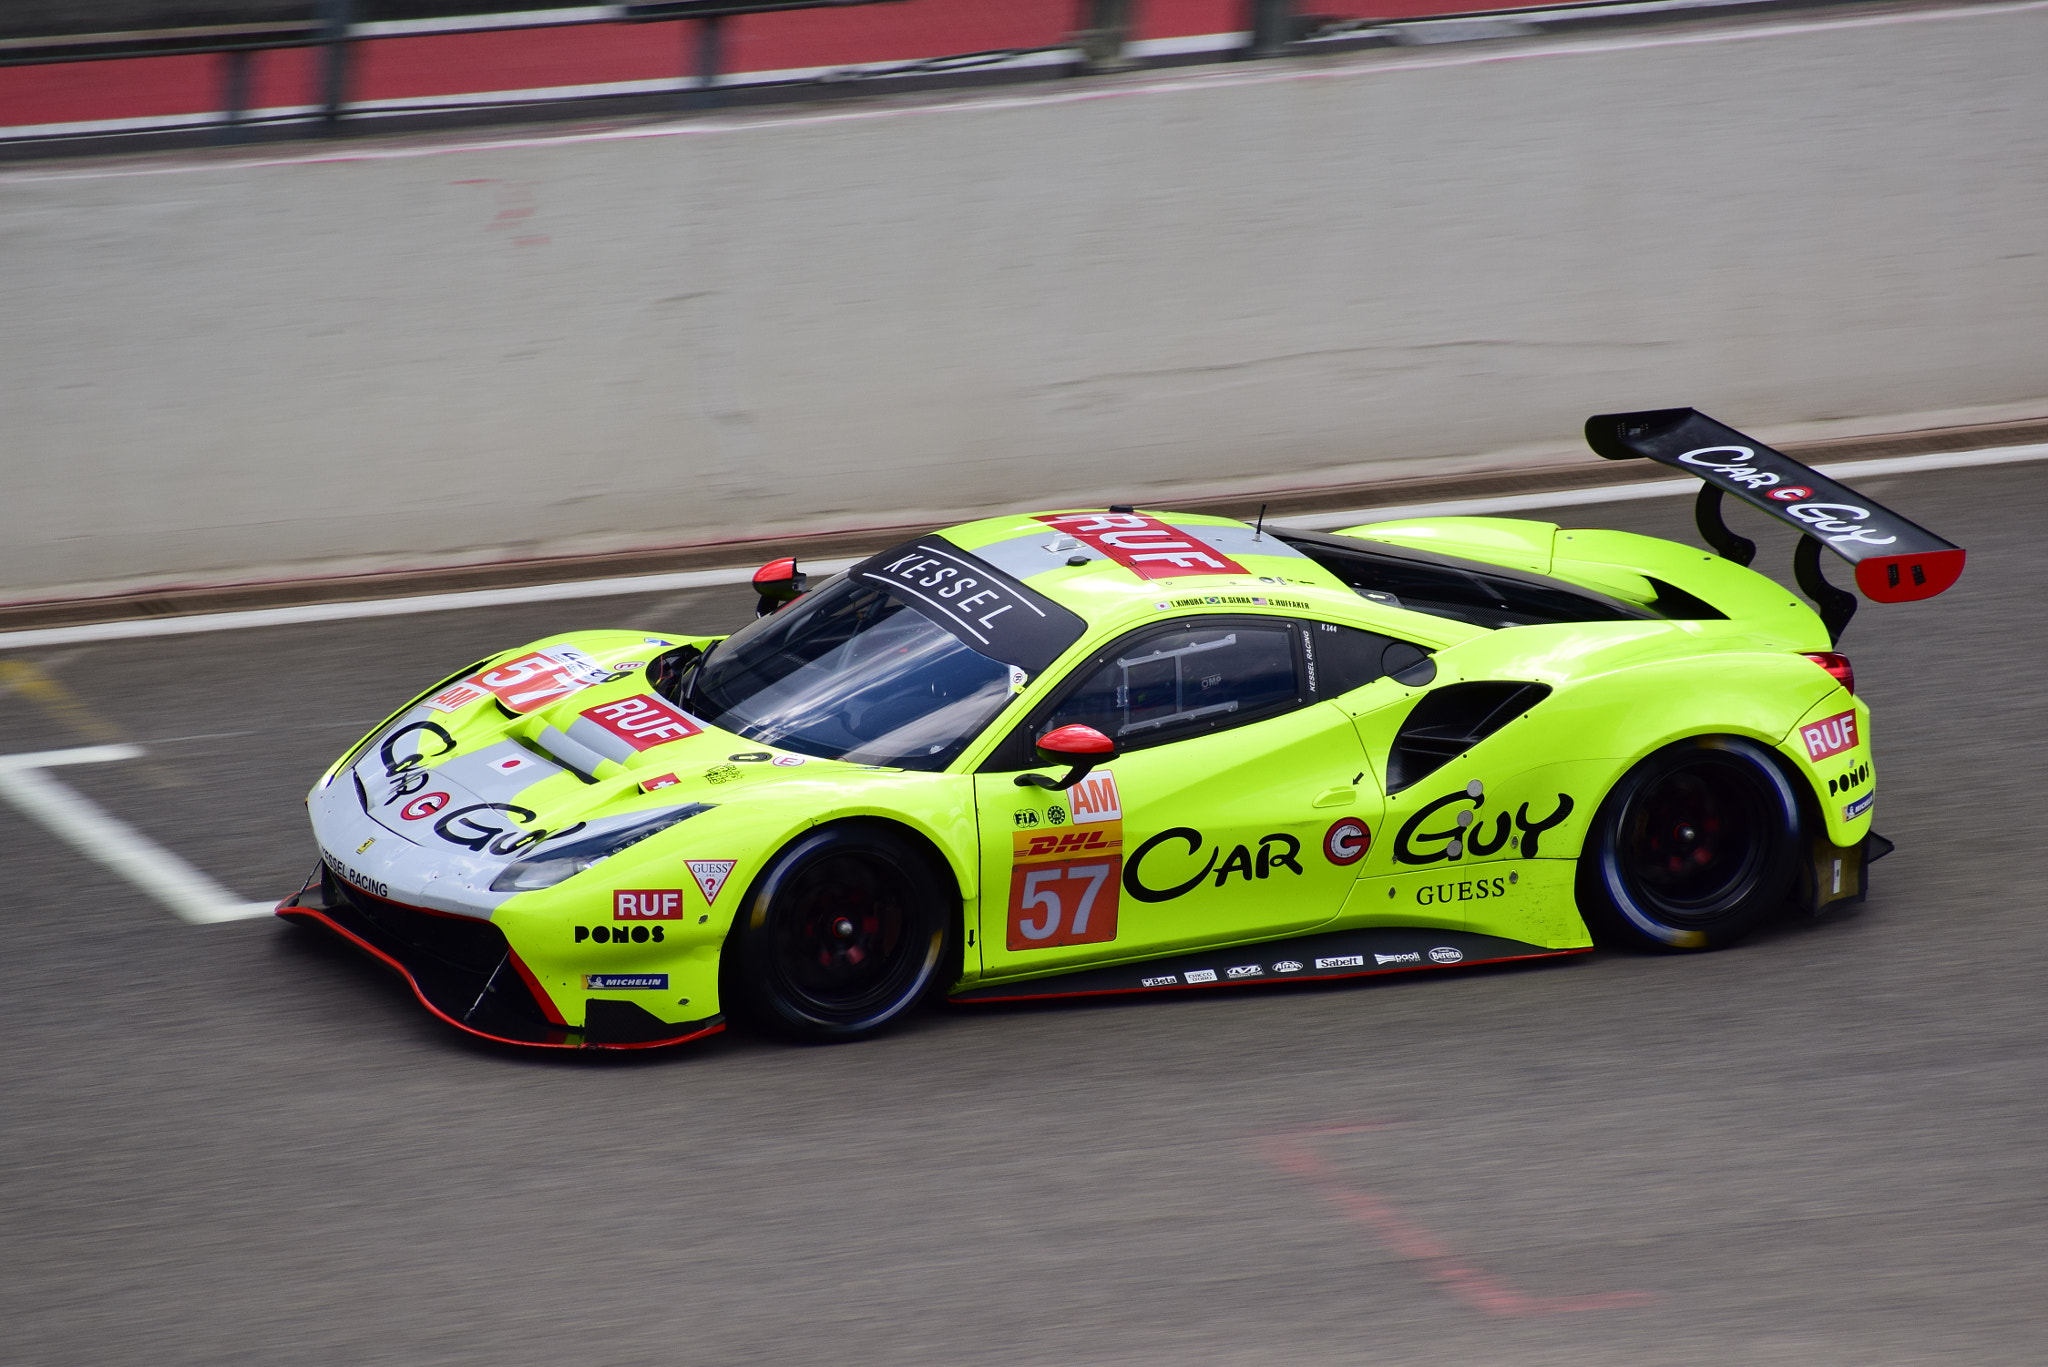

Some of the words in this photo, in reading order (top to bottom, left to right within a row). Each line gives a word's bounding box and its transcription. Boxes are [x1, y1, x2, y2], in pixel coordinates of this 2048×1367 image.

[1678, 446, 1780, 489] CAR
[1055, 513, 1227, 568] RUF
[883, 553, 1013, 630] KESSEL
[1303, 630, 1313, 660] RACING
[482, 656, 584, 705] 57
[1201, 676, 1222, 688] OMP
[1308, 661, 1316, 692] KESSEL
[435, 686, 482, 708] AM
[593, 698, 690, 739] RUF
[1804, 715, 1854, 756] RUF
[1828, 760, 1869, 798] PONOS
[1073, 778, 1118, 815] AM
[1028, 830, 1108, 856] DHL
[1122, 826, 1304, 903] CAR
[1393, 788, 1575, 865] GUY
[349, 868, 388, 897] RACING
[692, 863, 728, 874] GUESS
[618, 893, 679, 916] RUF
[1019, 864, 1110, 940] 57
[1416, 877, 1506, 906] GUESS
[574, 925, 665, 943] PONOS
[1320, 957, 1359, 968] Sabelt
[605, 978, 662, 986] MICHELIN
[1152, 976, 1176, 985] Beta
